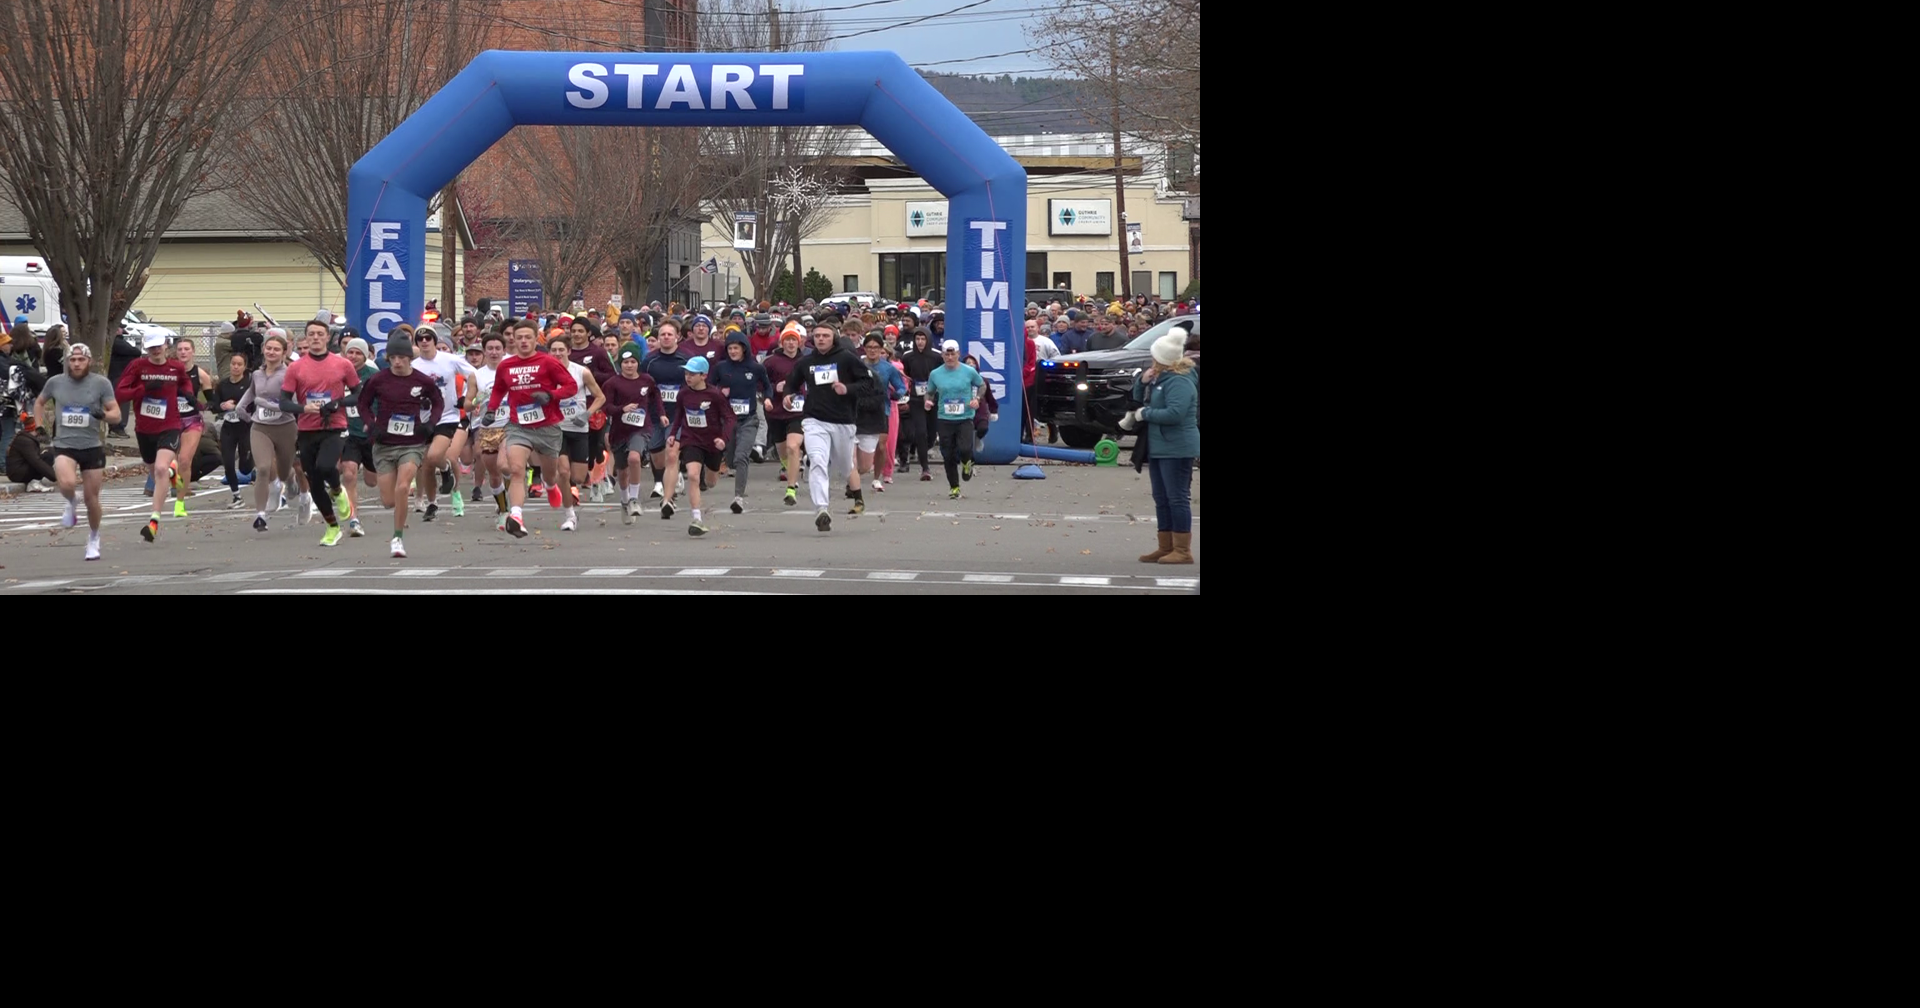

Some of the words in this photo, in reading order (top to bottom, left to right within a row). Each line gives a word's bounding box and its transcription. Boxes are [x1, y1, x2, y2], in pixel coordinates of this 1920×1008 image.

[565, 62, 805, 110] START
[364, 222, 407, 358] FALC
[509, 365, 540, 375] WAVERLY
[517, 373, 531, 385] XC
[821, 372, 830, 380] 47
[661, 391, 675, 400] 910
[145, 404, 161, 415] 609
[948, 404, 960, 412] 307
[67, 414, 84, 425] 899
[522, 410, 539, 422] 679
[626, 412, 641, 423] 605
[393, 422, 409, 432] 571
